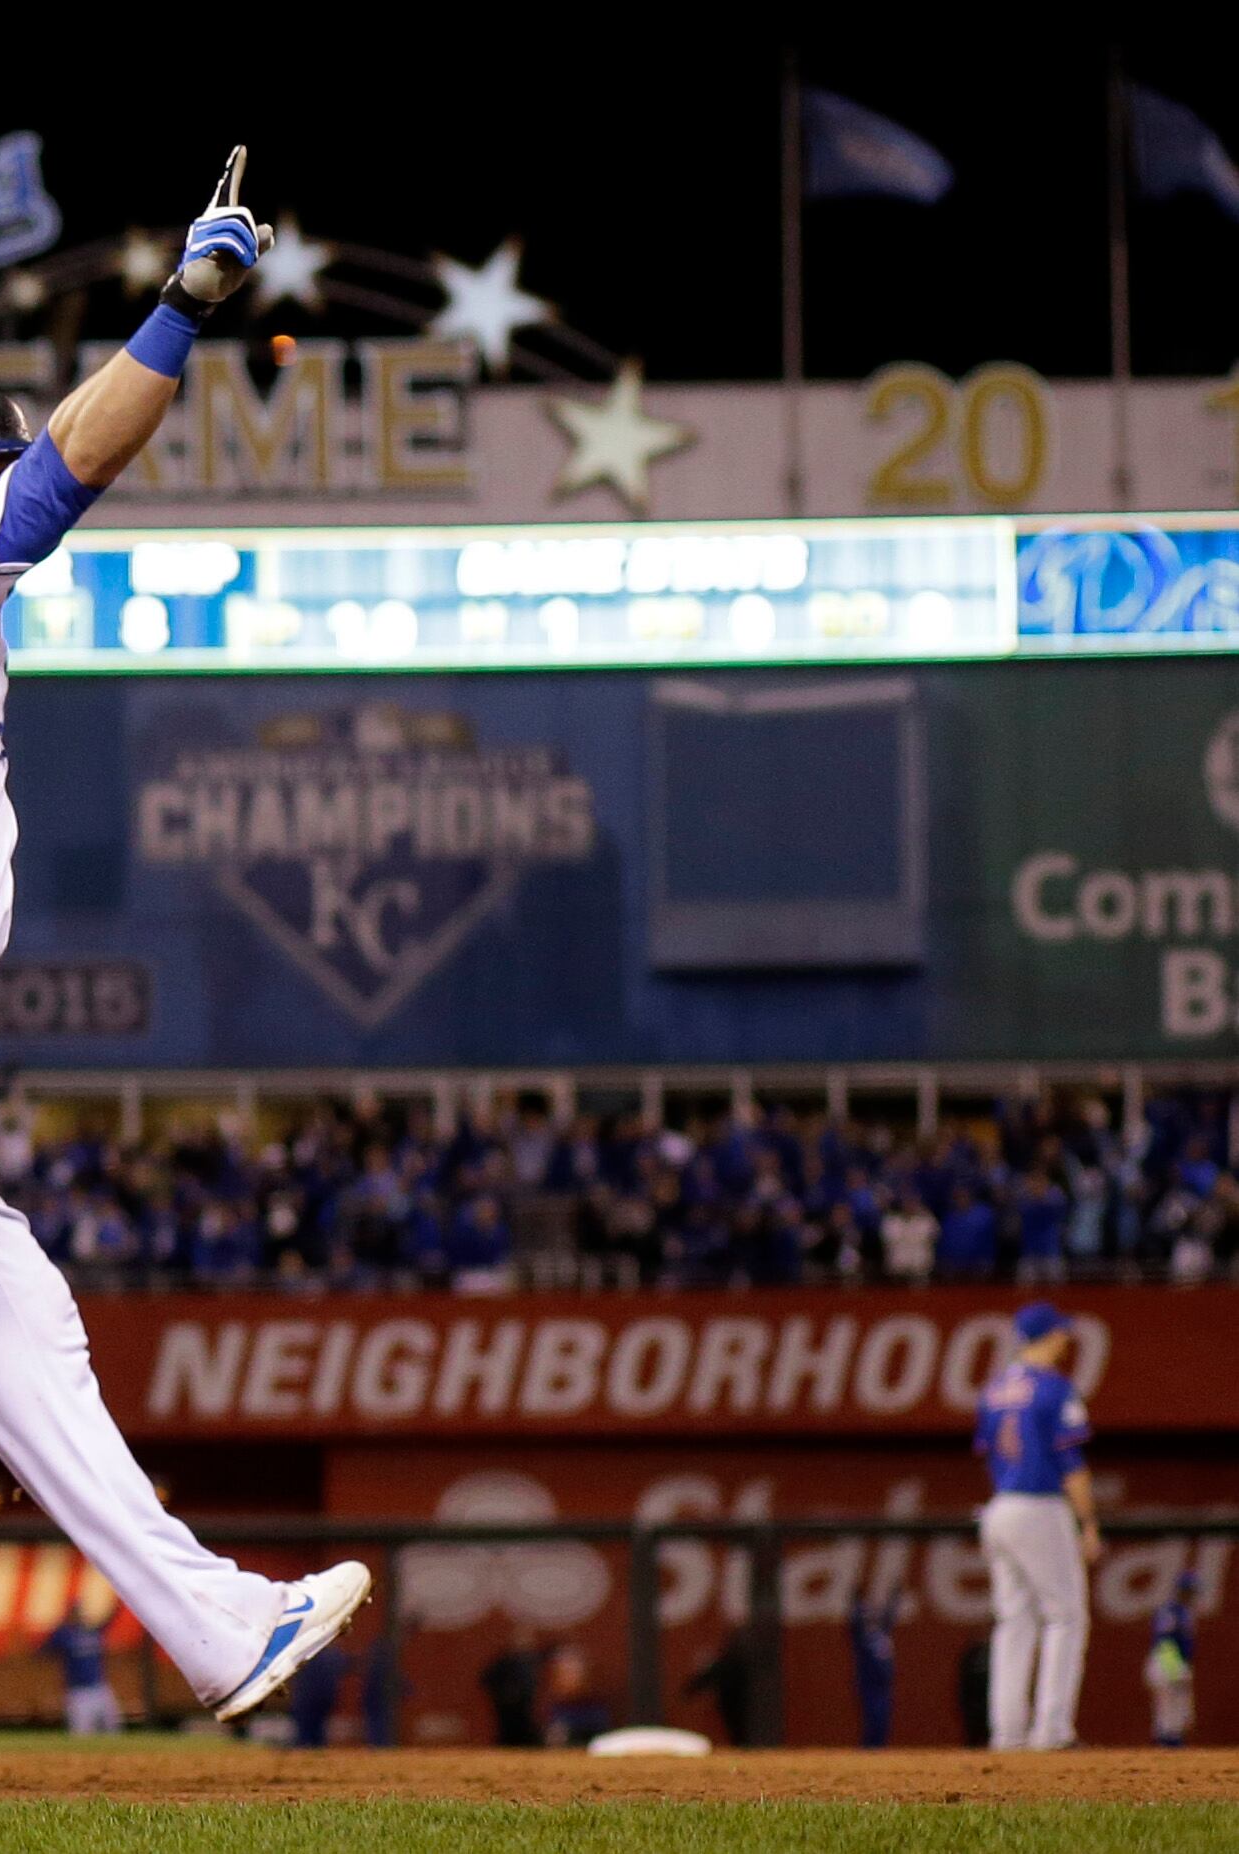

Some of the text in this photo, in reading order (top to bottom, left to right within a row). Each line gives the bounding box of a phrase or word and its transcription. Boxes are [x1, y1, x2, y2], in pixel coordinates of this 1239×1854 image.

[863, 361, 1051, 507] 20
[139, 774, 595, 863] CHAMPIONS
[310, 858, 420, 972] KC
[1011, 850, 1239, 943] Com
[1162, 946, 1239, 1037] B
